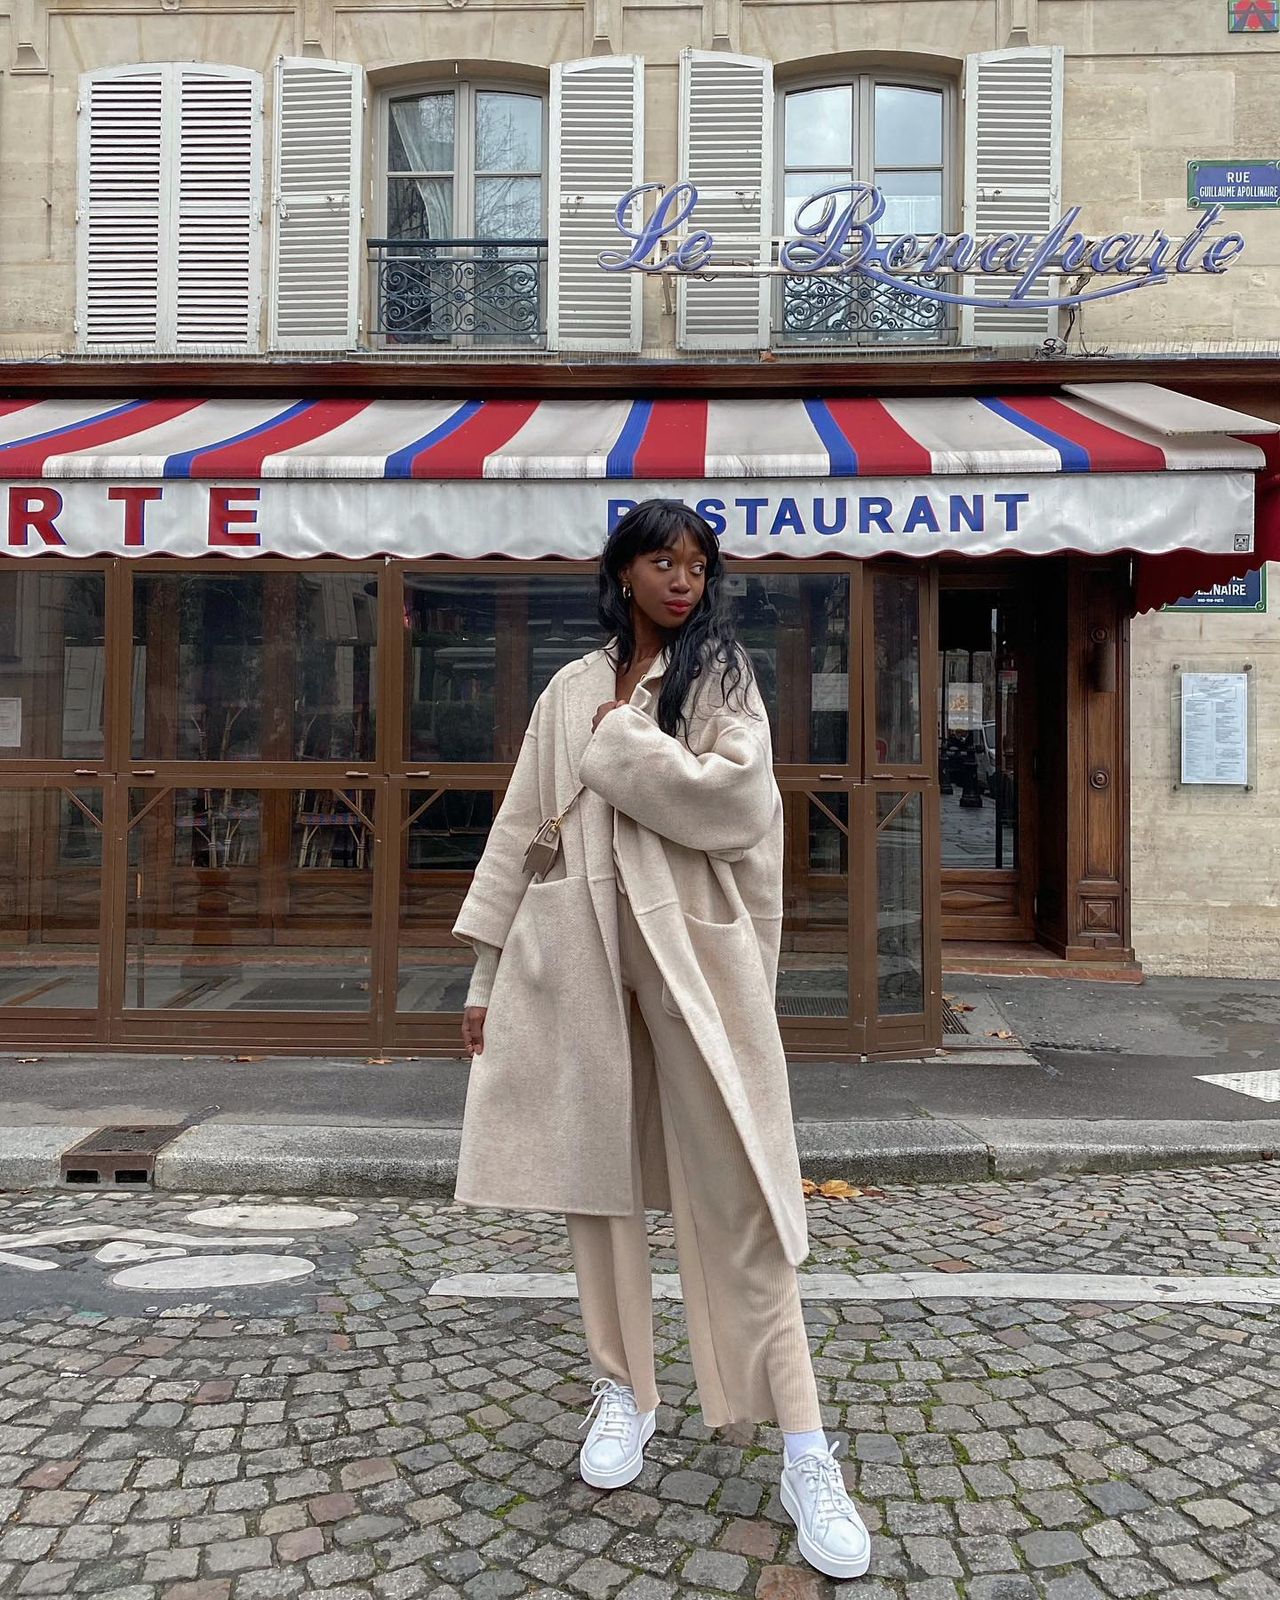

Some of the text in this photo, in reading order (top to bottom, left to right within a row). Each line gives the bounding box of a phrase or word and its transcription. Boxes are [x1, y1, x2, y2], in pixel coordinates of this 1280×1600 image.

[1227, 171, 1250, 183] RUE
[1200, 186, 1278, 197] GUILLAUME APOLLINAIRE
[597, 181, 1245, 308] Le Bonaparte
[607, 493, 1029, 536] RSTAURANT
